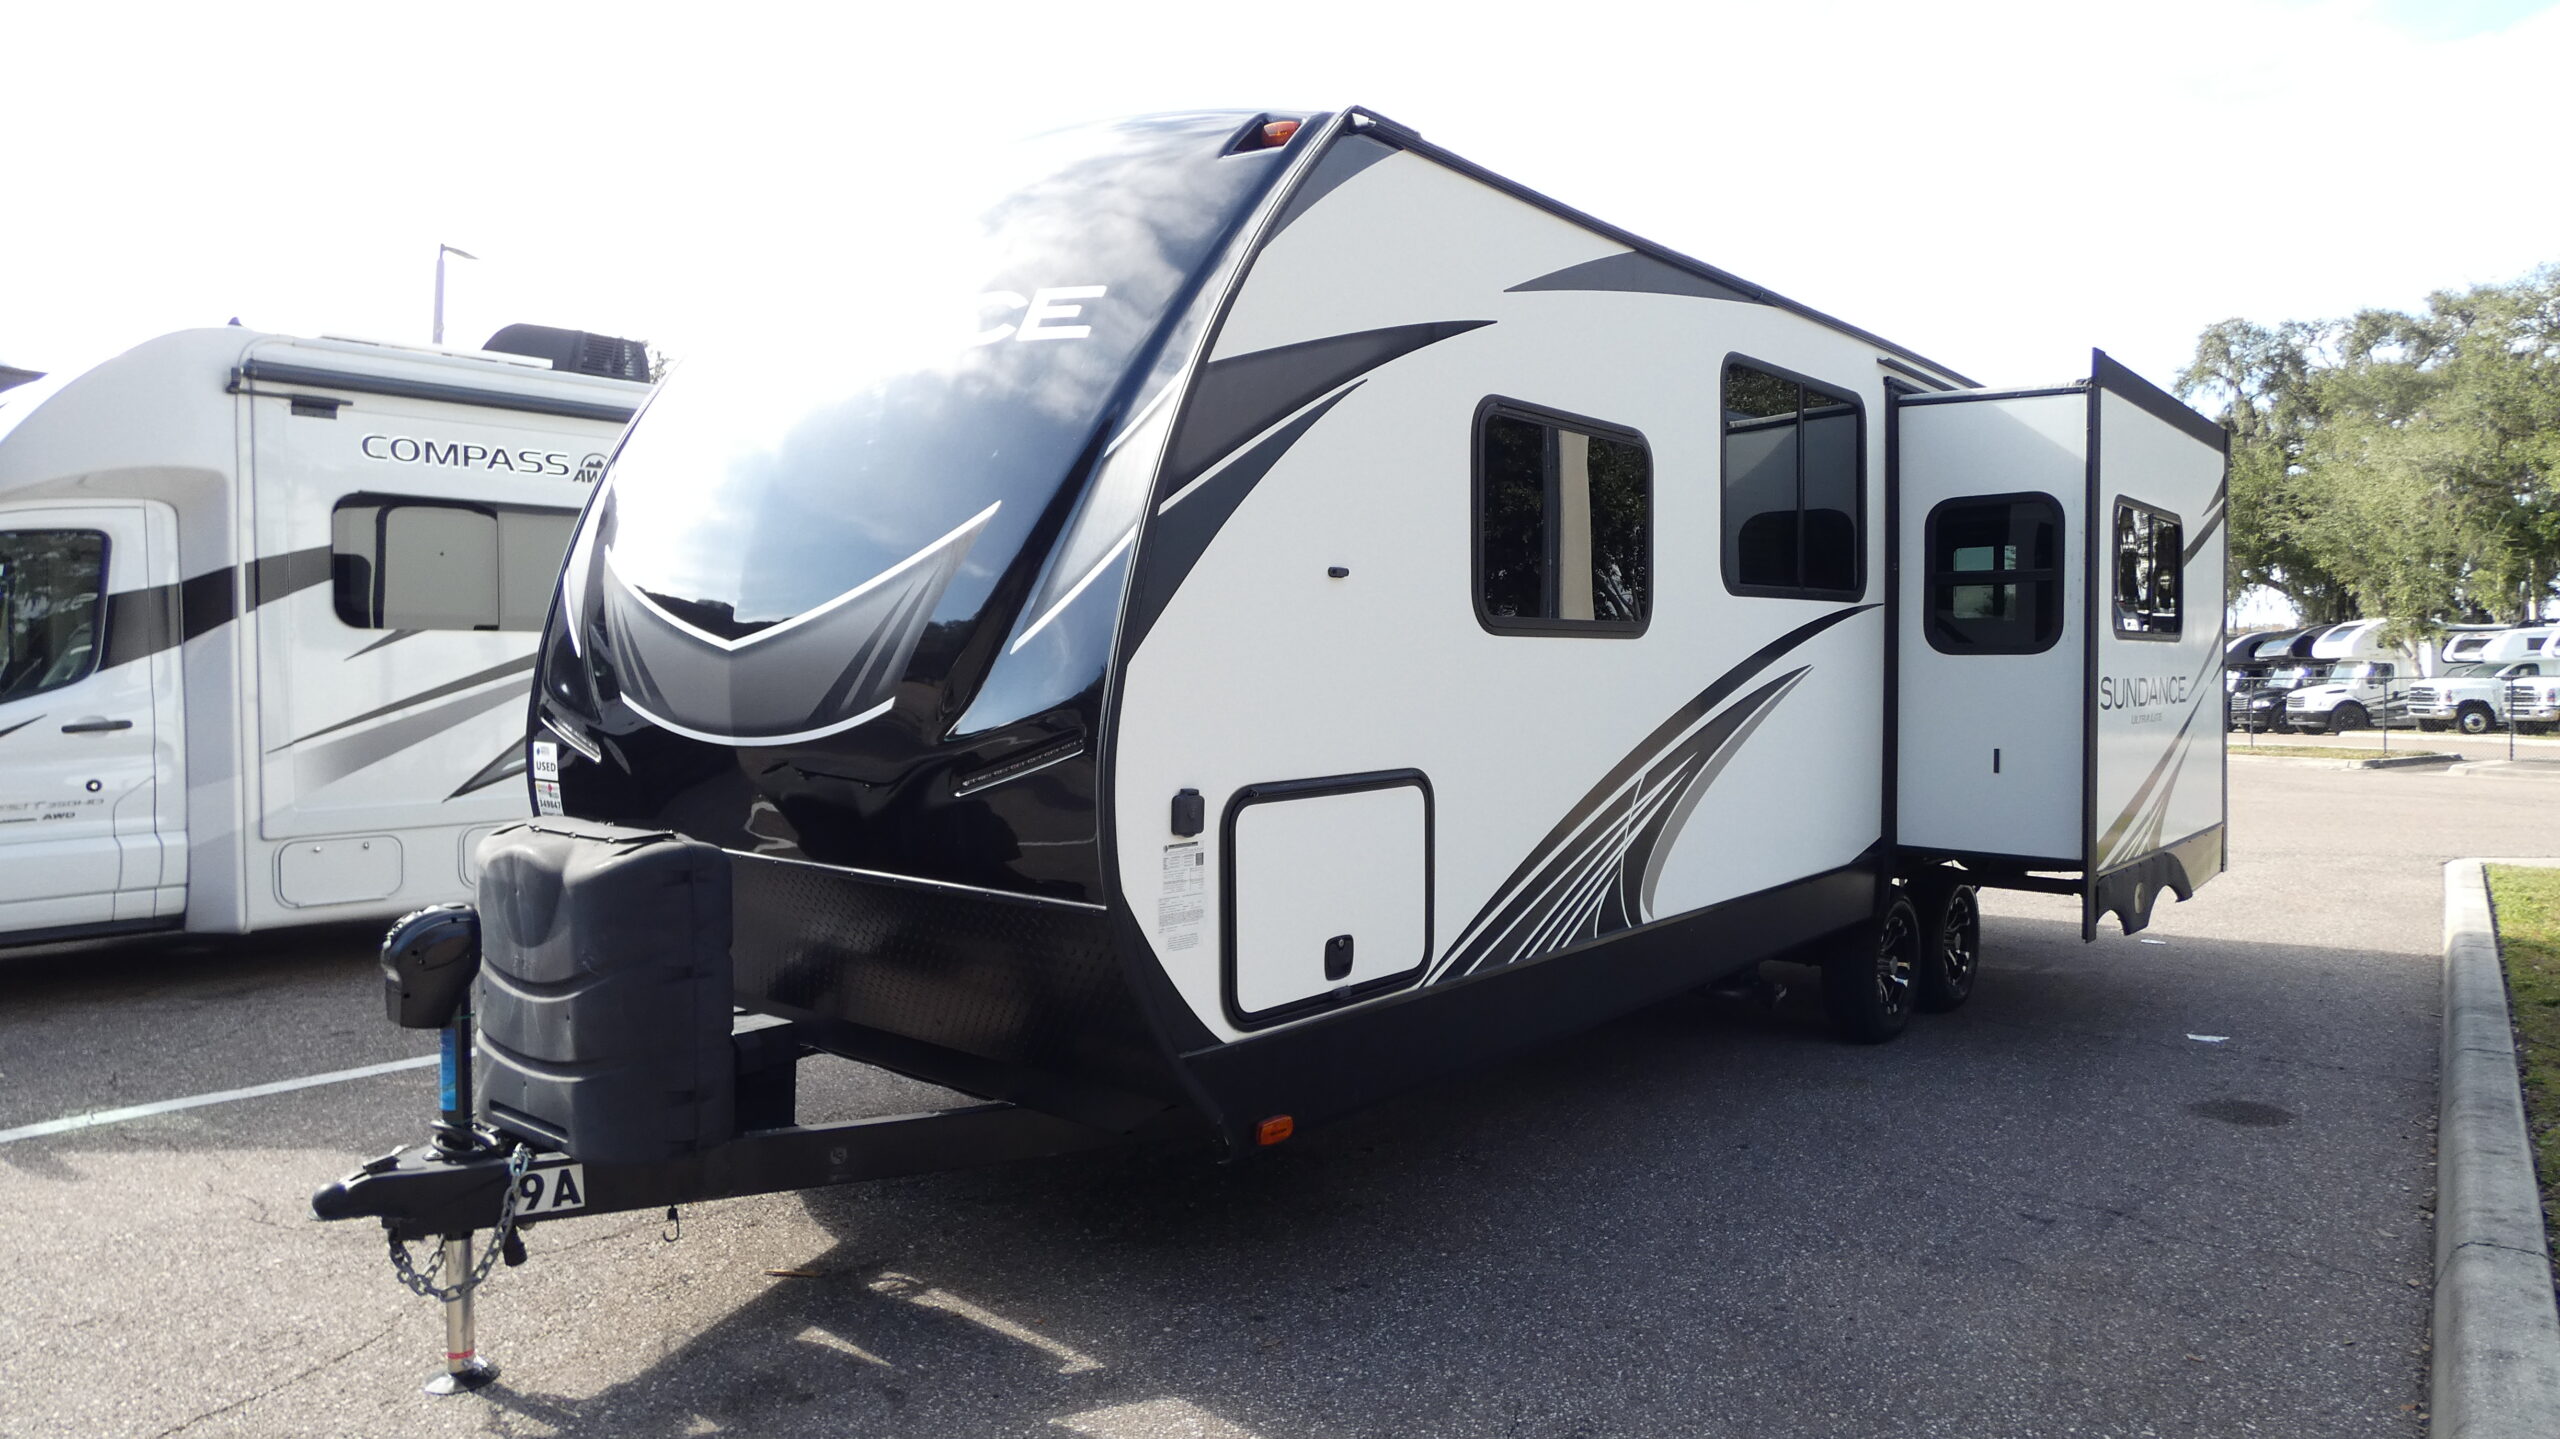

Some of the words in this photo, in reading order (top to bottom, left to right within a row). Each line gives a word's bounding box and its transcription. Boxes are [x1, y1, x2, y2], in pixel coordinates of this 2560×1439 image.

[361, 435, 570, 476] COMPASS
[2100, 676, 2187, 710] SUNDANCE
[536, 760, 557, 772] USED
[42, 811, 76, 821] AWD
[520, 1167, 582, 1212] 9A
